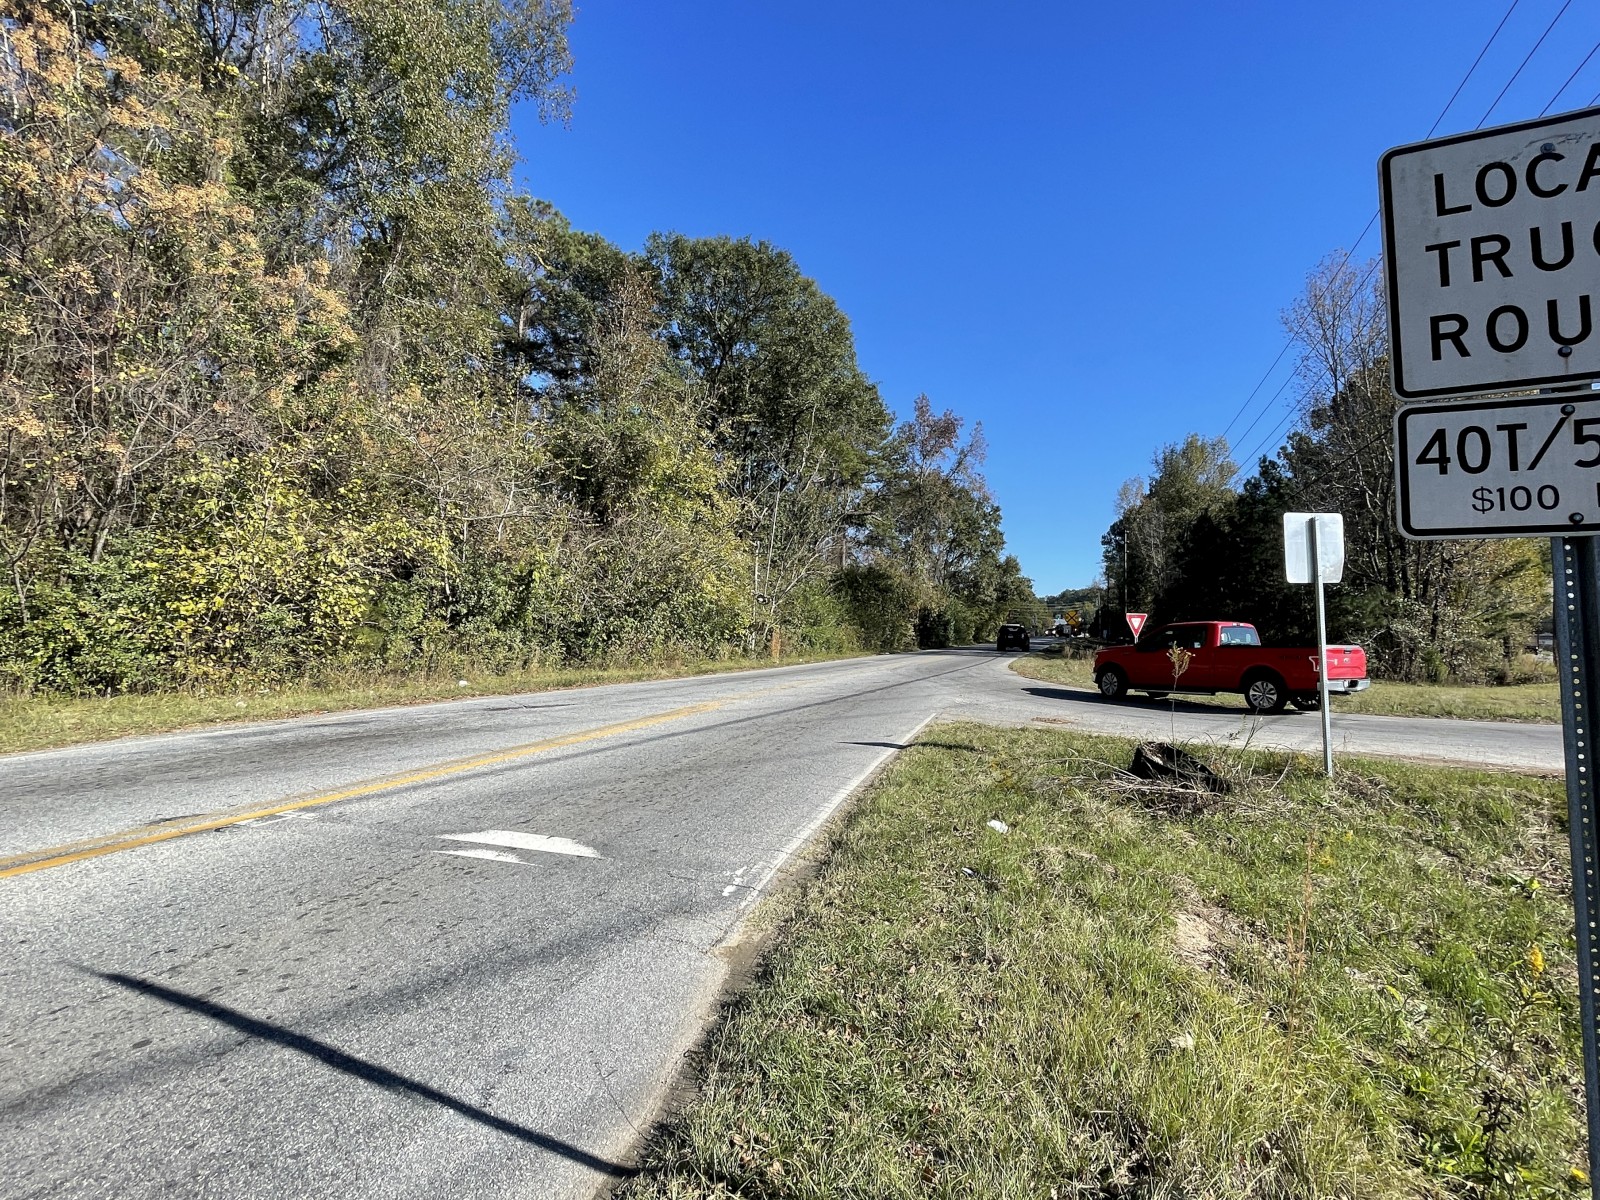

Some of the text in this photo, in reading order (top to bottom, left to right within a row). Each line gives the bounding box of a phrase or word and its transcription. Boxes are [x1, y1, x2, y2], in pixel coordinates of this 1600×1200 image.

[1425, 219, 1600, 287] TRU
[1429, 295, 1592, 361] ROU
[1416, 416, 1600, 475] 40T/5
[1471, 484, 1560, 514] $100
